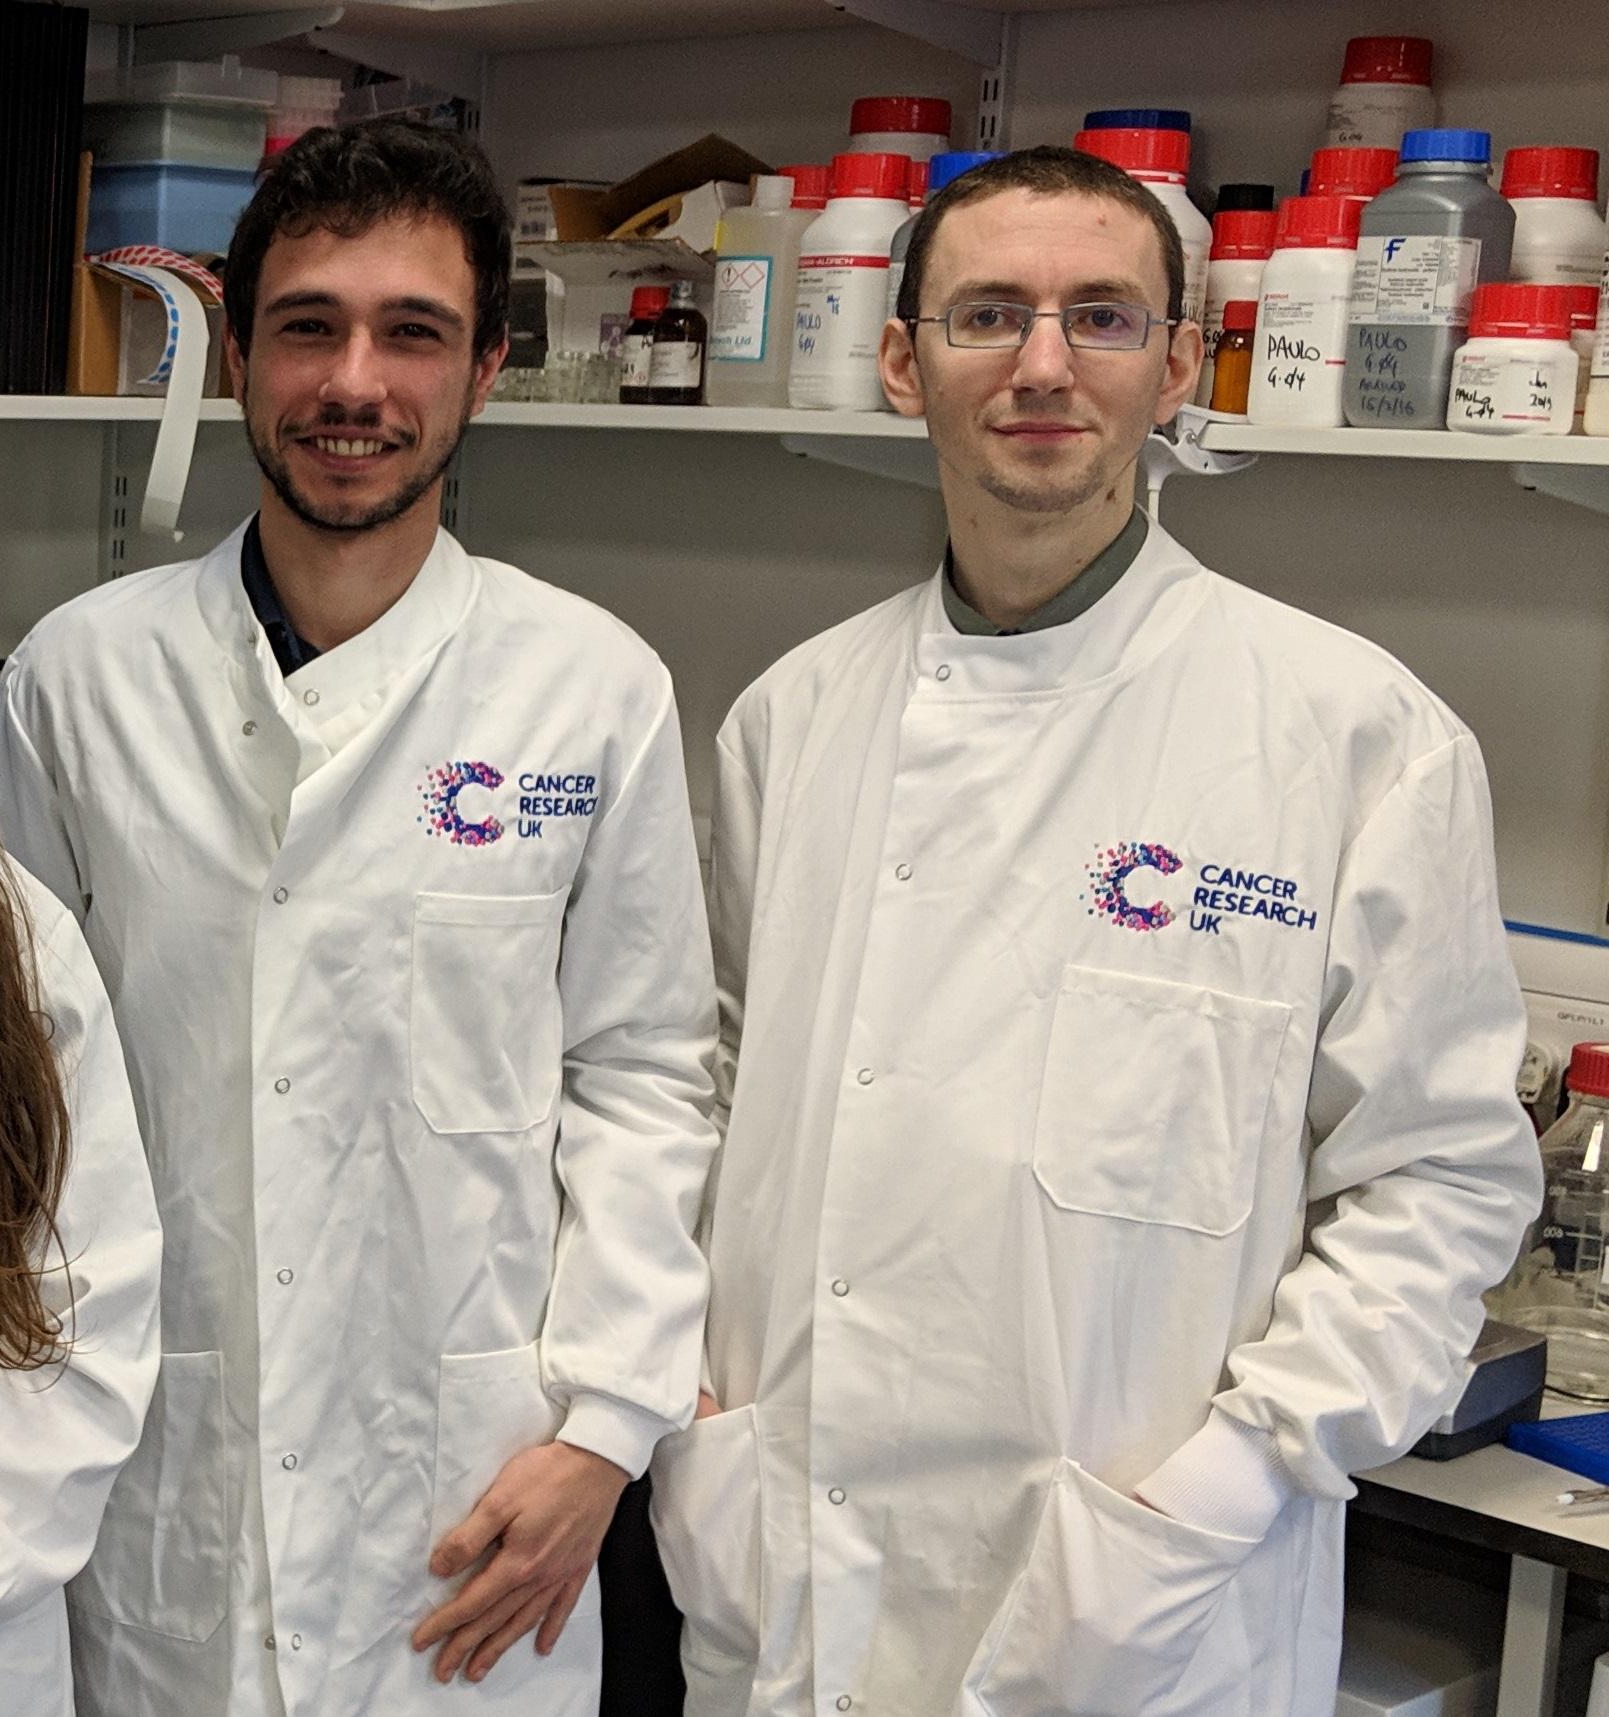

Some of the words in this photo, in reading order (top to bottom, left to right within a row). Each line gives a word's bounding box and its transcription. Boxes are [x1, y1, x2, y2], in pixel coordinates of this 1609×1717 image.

[1267, 333, 1320, 361] PAULO
[1359, 328, 1407, 351] PAULO
[1455, 387, 1492, 405] PAULO
[518, 773, 596, 794] CANCER
[518, 819, 543, 838] UK
[1200, 864, 1298, 900] CANCER
[1193, 886, 1318, 930] RESEARCH
[1189, 911, 1222, 935] UK
